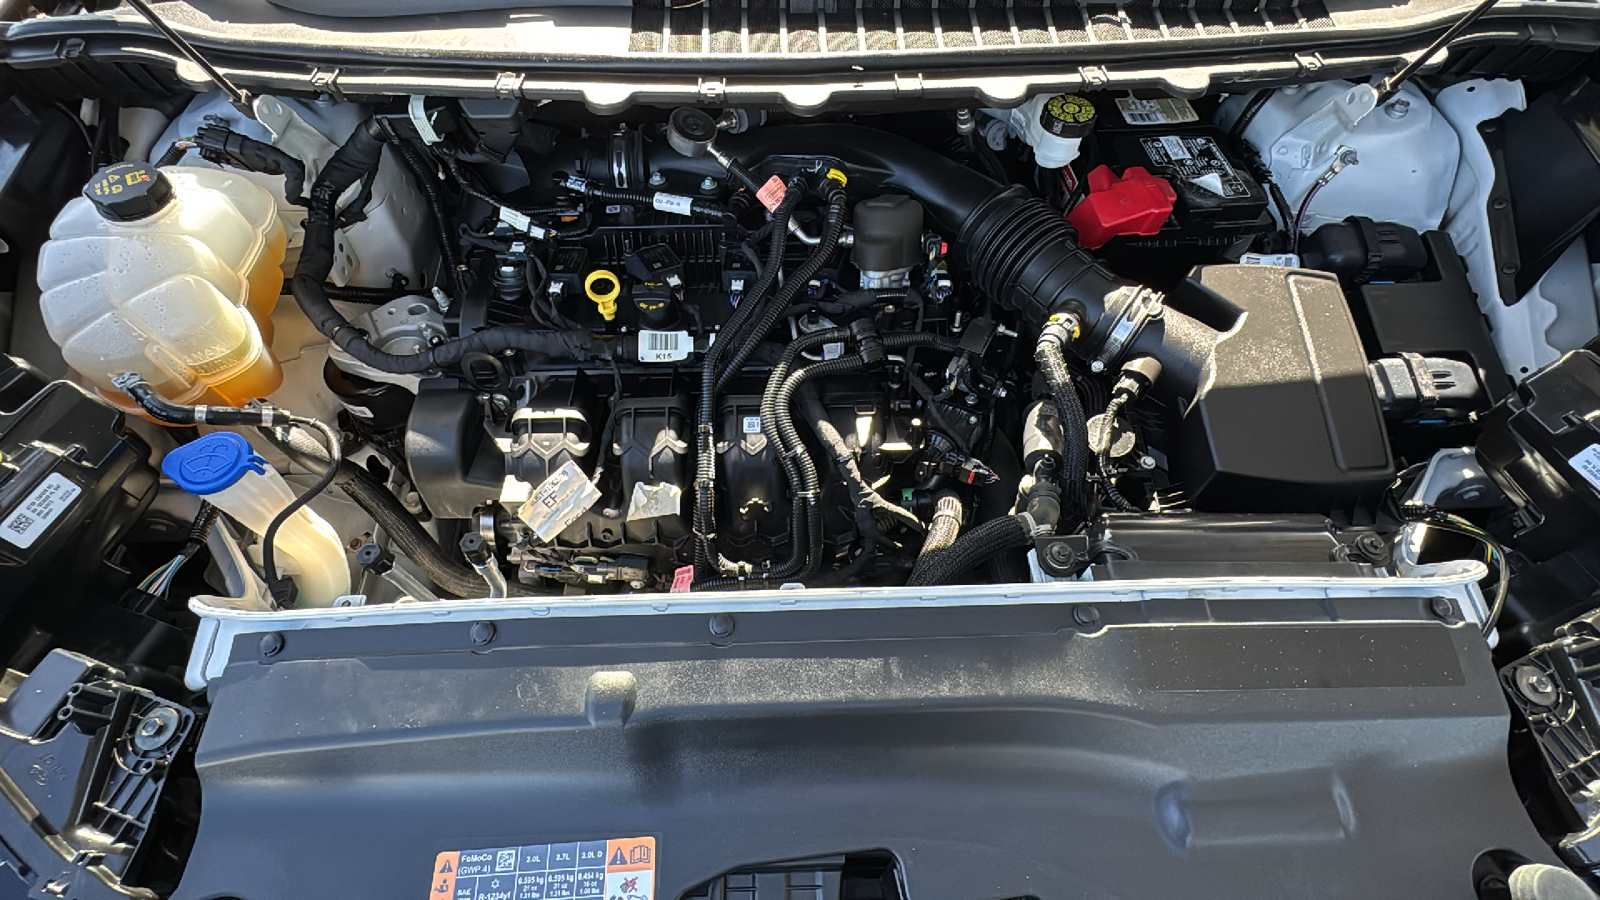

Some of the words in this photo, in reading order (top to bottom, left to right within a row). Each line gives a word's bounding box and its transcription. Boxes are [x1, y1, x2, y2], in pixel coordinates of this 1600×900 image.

[191, 343, 228, 362] MAX
[655, 352, 673, 360] K15
[541, 489, 558, 509] EF
[581, 851, 595, 859] 2.0L
